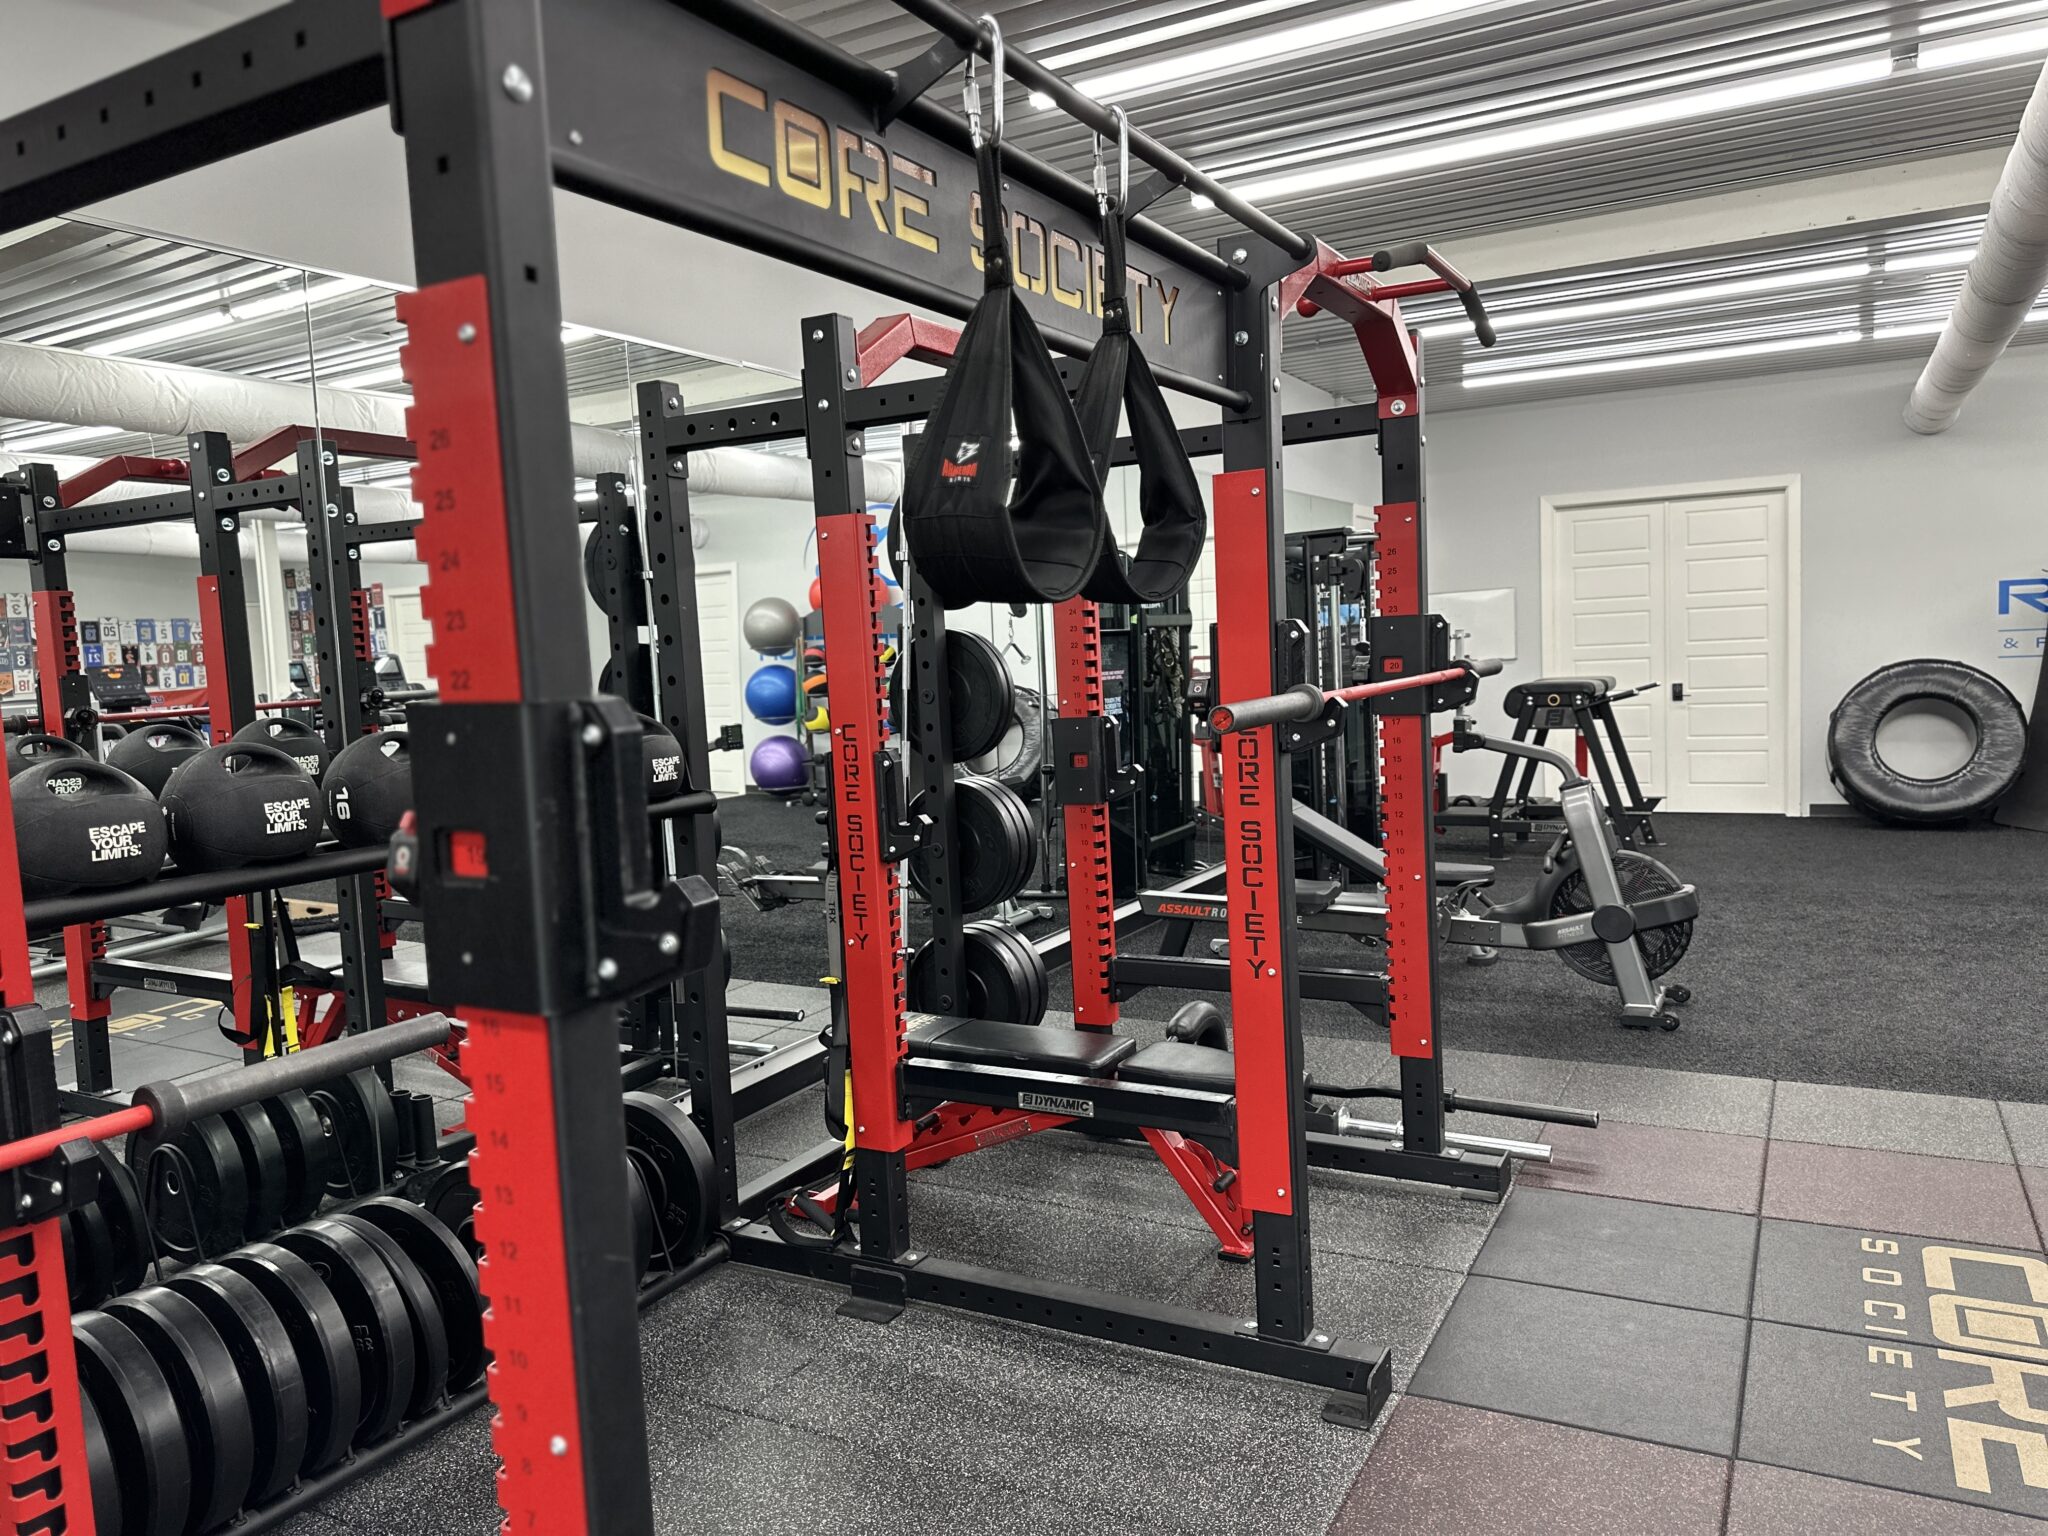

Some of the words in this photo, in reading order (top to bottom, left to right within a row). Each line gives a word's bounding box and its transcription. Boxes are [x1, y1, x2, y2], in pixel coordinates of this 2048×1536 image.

[706, 68, 939, 254] CORE
[431, 429, 450, 450] 26
[435, 490, 455, 511] 25
[1387, 548, 1397, 556] 26
[440, 552, 461, 572] 24
[1387, 567, 1397, 575] 25
[1387, 586, 1397, 594] 24
[1388, 605, 1398, 613] 23
[446, 611, 466, 631] 23
[2003, 637, 2019, 649] &
[1389, 662, 1399, 670] 20
[450, 671, 471, 690] 22
[1392, 717, 1401, 725] 17
[1392, 737, 1401, 745] 16
[652, 756, 680, 768] ESCAPE
[842, 724, 861, 802] CORE
[1392, 755, 1402, 763] 15
[653, 764, 675, 774] YOUR
[336, 786, 351, 820] 16
[1394, 792, 1403, 800] 13
[264, 798, 311, 814] ESCAPE
[266, 810, 301, 824] YOUR
[89, 821, 147, 840] ESCAPE
[90, 835, 133, 851] YOUR
[1396, 847, 1405, 855] 10
[847, 814, 868, 950] SOCIETY
[1240, 820, 1266, 980] SOCIETY
[828, 901, 837, 924] TRX
[1158, 903, 1227, 918] ASSAULTRO
[486, 1073, 506, 1093] 15
[1034, 1095, 1090, 1112] DYNAMIC
[490, 1131, 509, 1149] 14
[495, 1185, 513, 1205] 13
[499, 1240, 518, 1260] 12
[504, 1295, 522, 1315] 11
[1860, 1237, 1923, 1462] SOCIETY
[509, 1349, 529, 1370] 10
[1921, 1245, 2048, 1494] CORE
